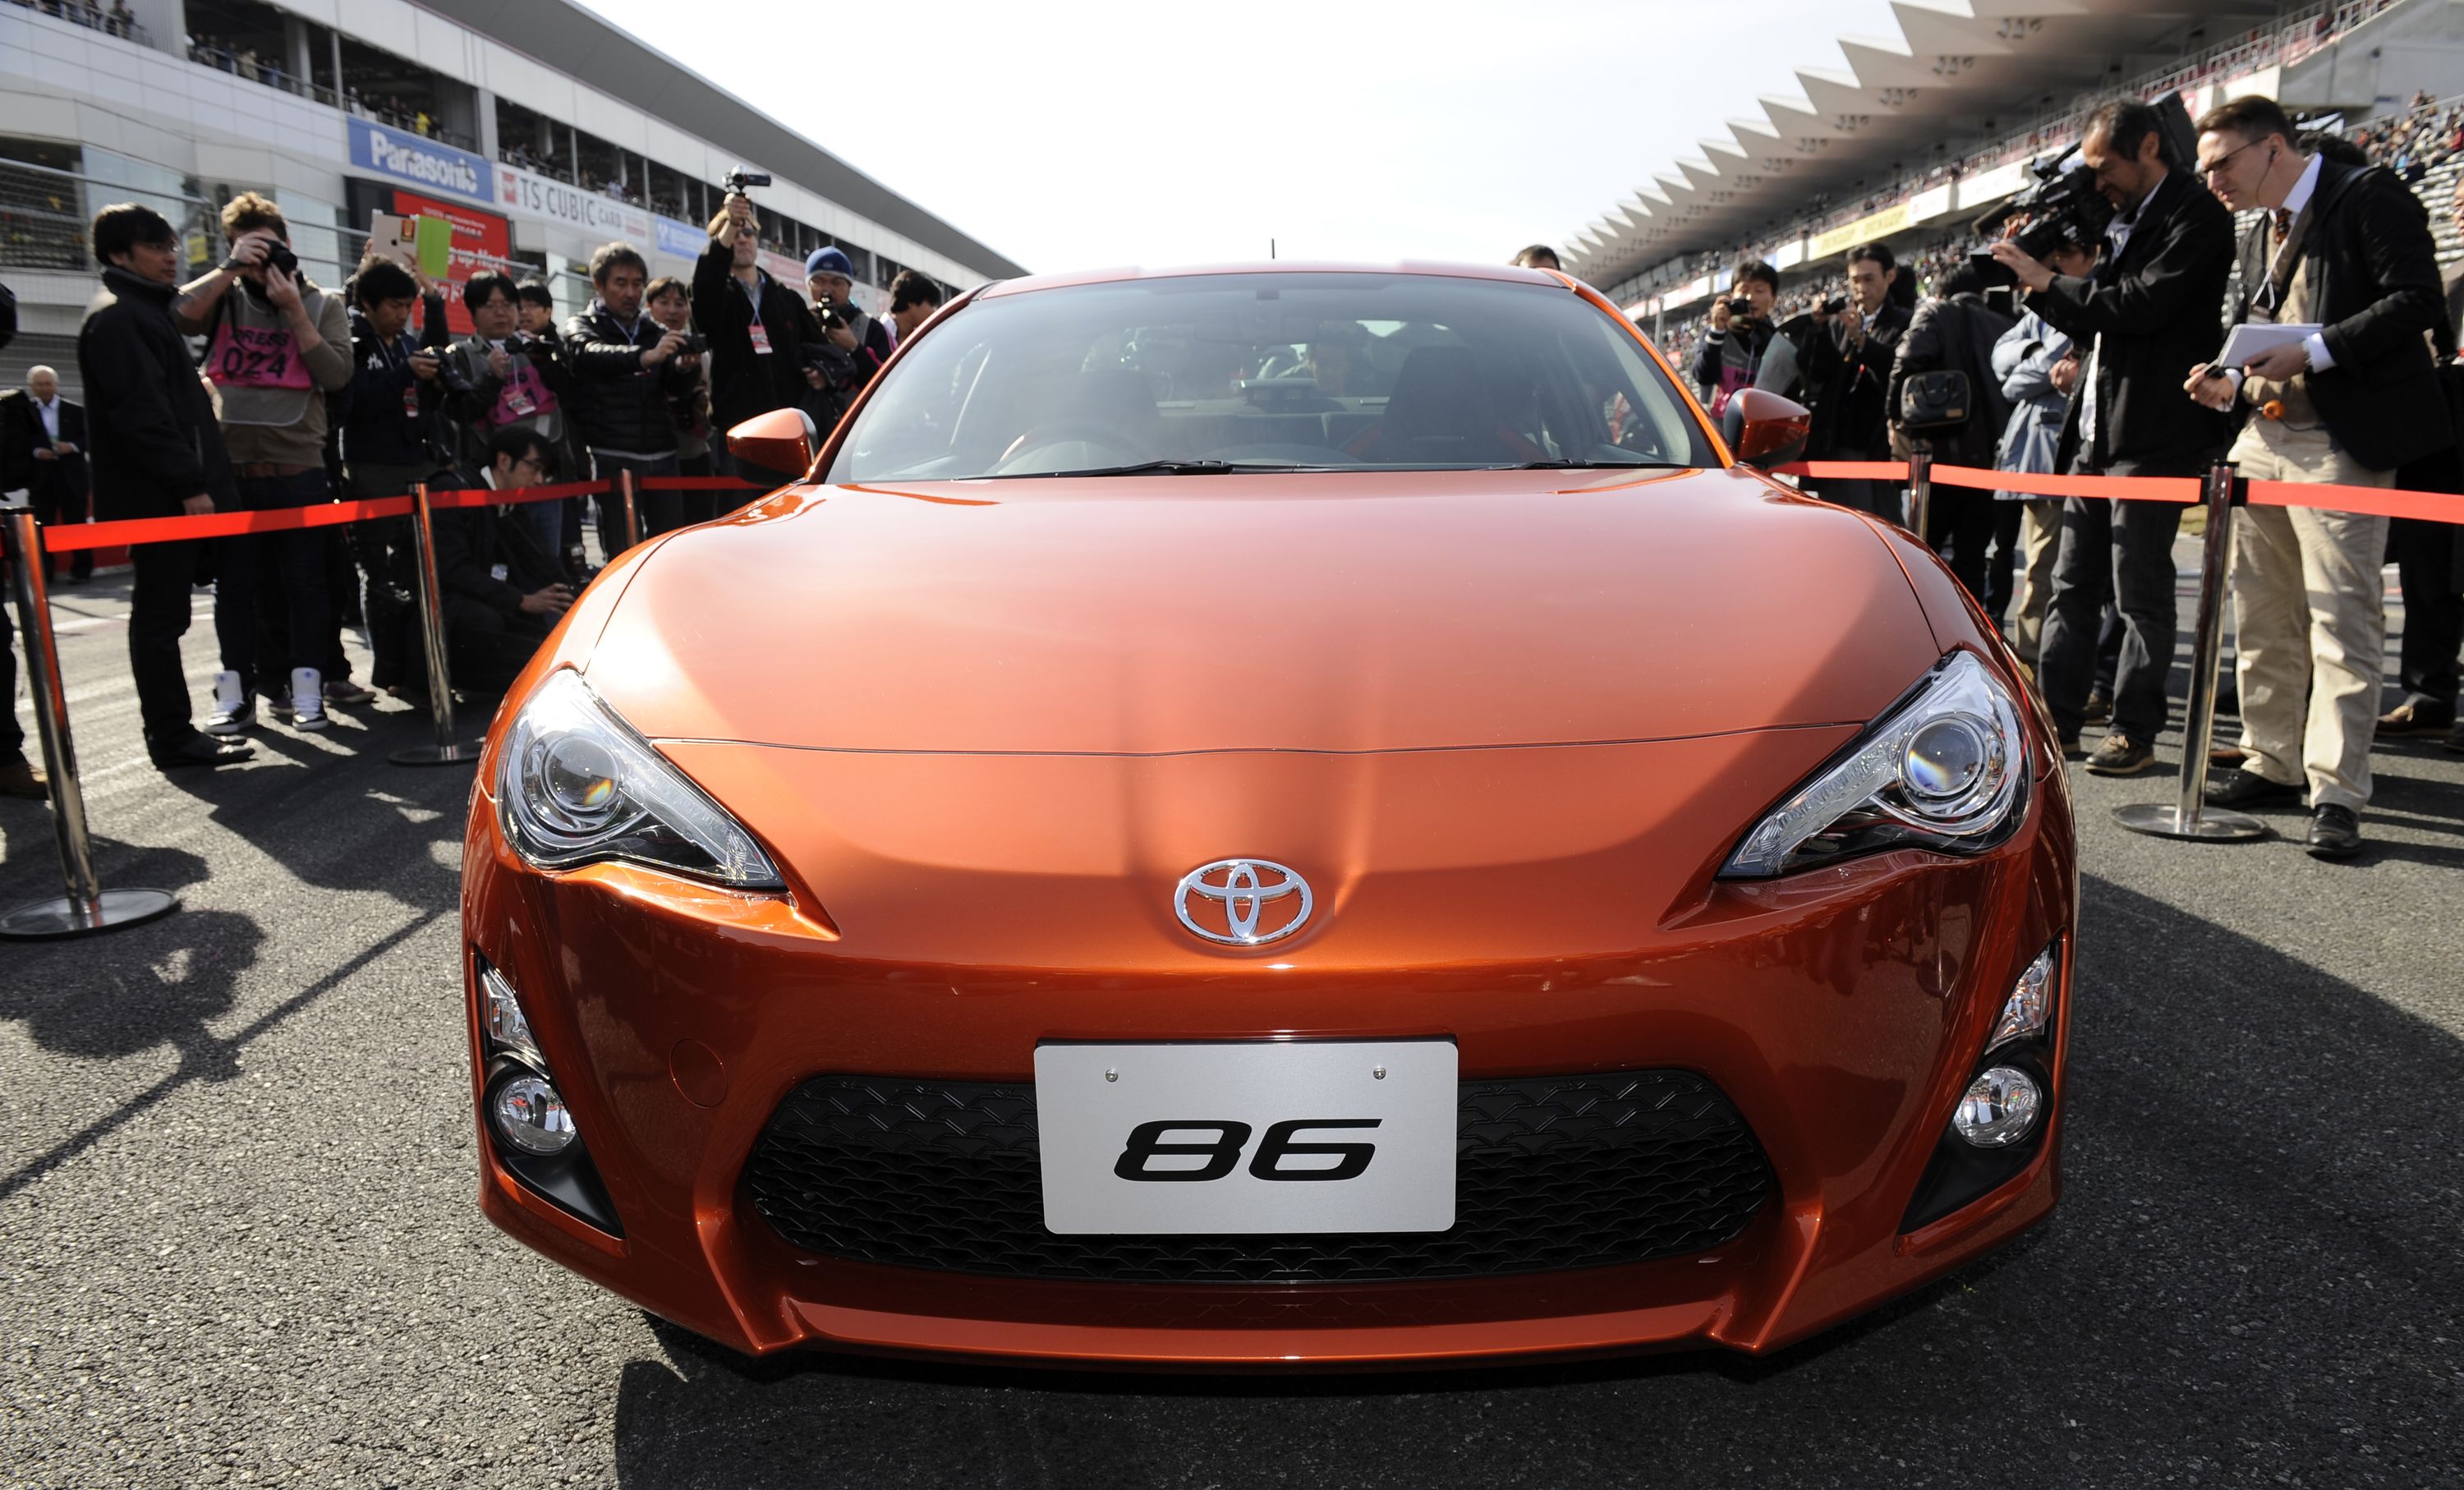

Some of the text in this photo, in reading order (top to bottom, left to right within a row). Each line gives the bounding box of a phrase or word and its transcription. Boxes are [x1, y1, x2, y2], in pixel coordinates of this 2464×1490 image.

[370, 131, 477, 193] Panasonic
[521, 177, 540, 209] TS
[546, 187, 595, 226] CUBIC
[223, 347, 287, 379] 024
[1114, 1118, 1383, 1182] 86
